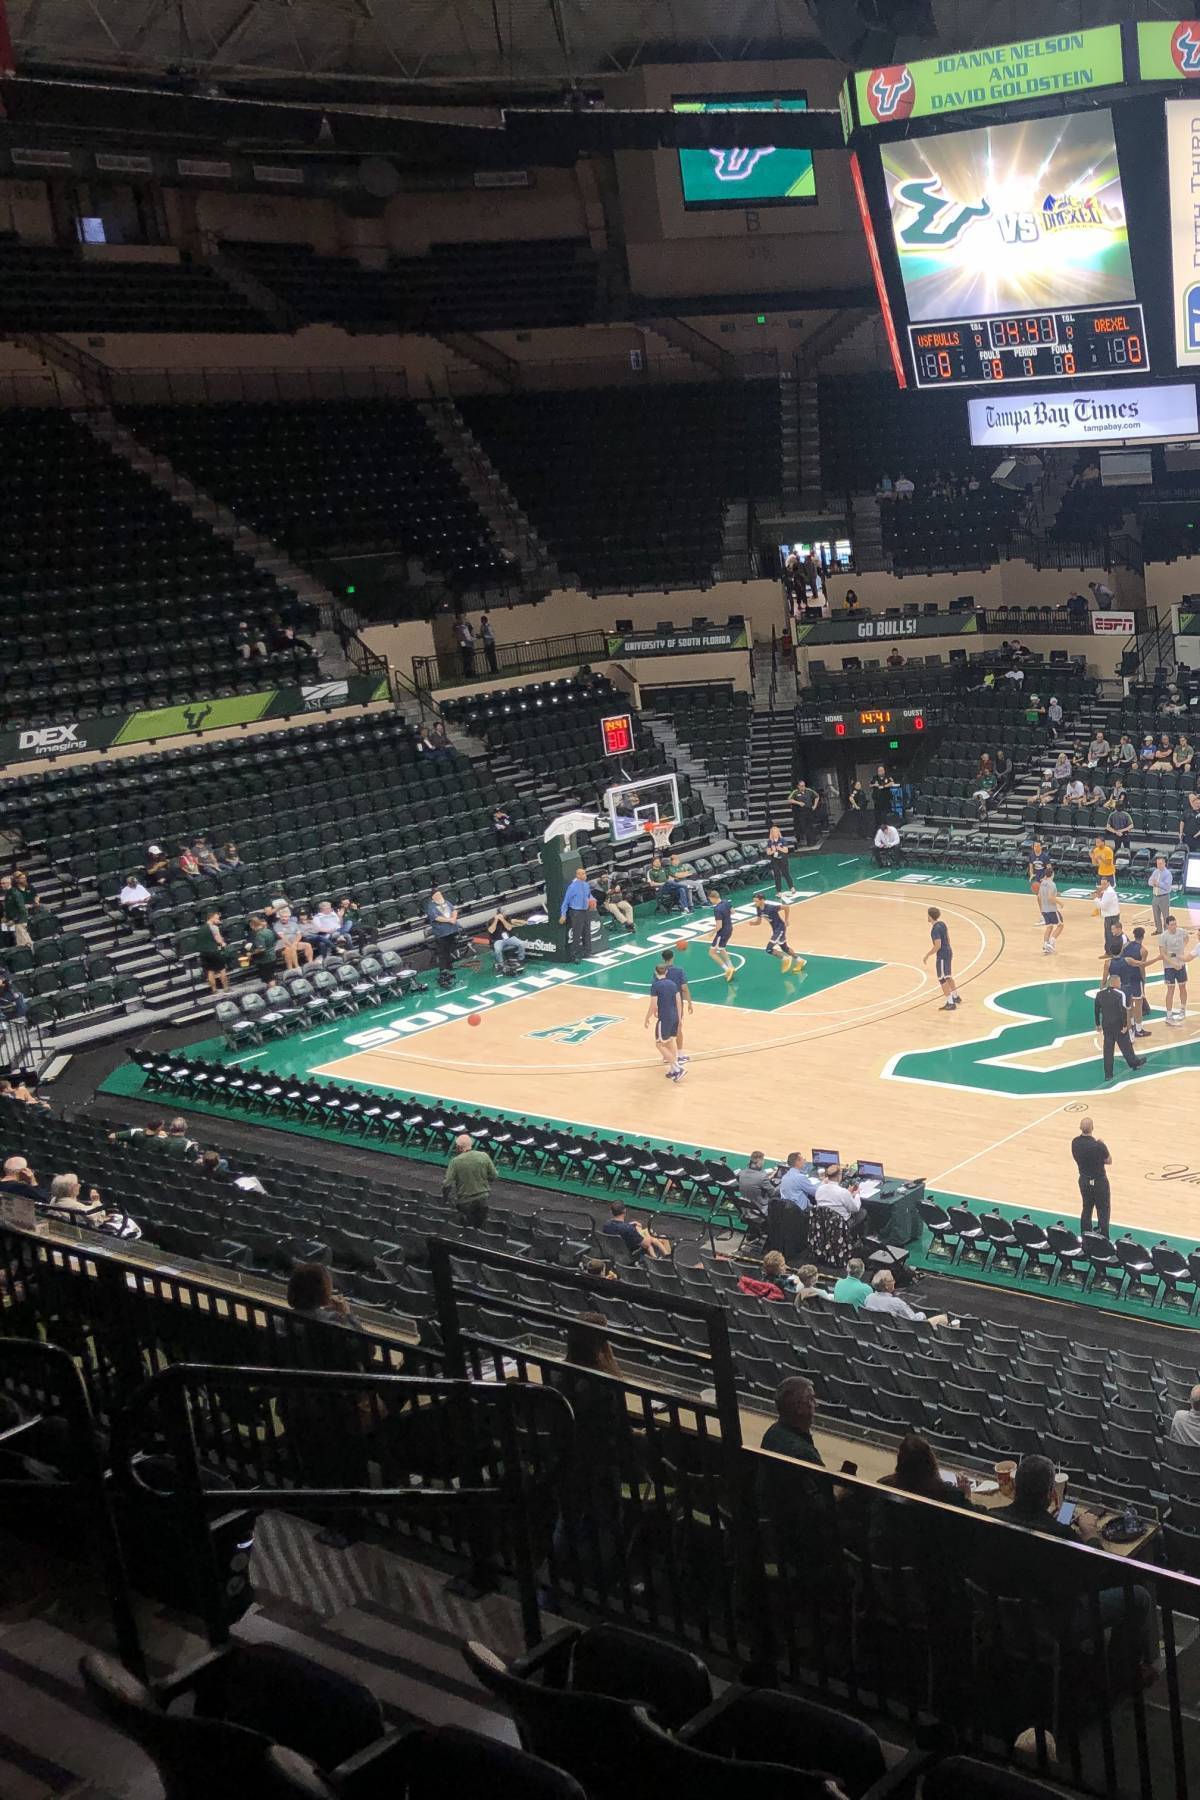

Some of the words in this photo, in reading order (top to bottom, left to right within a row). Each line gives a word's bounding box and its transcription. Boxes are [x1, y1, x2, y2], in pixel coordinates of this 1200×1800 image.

[934, 51, 1005, 75] JOANNE
[1010, 34, 1085, 60] NELSON
[989, 62, 1029, 82] AND
[930, 88, 986, 110] DAVID
[990, 68, 1093, 99] GOLDSTEIN
[997, 211, 1039, 244] VS
[1094, 316, 1130, 333] DREXEL
[979, 350, 1001, 360] FOULS
[1014, 348, 1038, 357] PERIOD
[1051, 345, 1073, 354] FOULS
[985, 406, 1031, 434] Tampa
[1033, 401, 1070, 428] Bay
[1073, 398, 1139, 422] Times
[1084, 422, 1141, 432] tampabay.com
[858, 623, 874, 637] GO
[877, 619, 917, 636] BULLS!
[1095, 618, 1133, 631] ESPN
[625, 638, 665, 651] UNIVERSITY
[667, 638, 676, 648] OF
[678, 637, 700, 647] SOUTH
[703, 635, 731, 645] FLORIDA
[825, 715, 843, 723] HOME
[860, 711, 891, 724] 14:41
[903, 709, 923, 717] GUEST
[19, 723, 79, 749] DEX
[607, 731, 629, 751] 30
[927, 875, 982, 888] USF
[344, 967, 578, 1049] SOUTH
